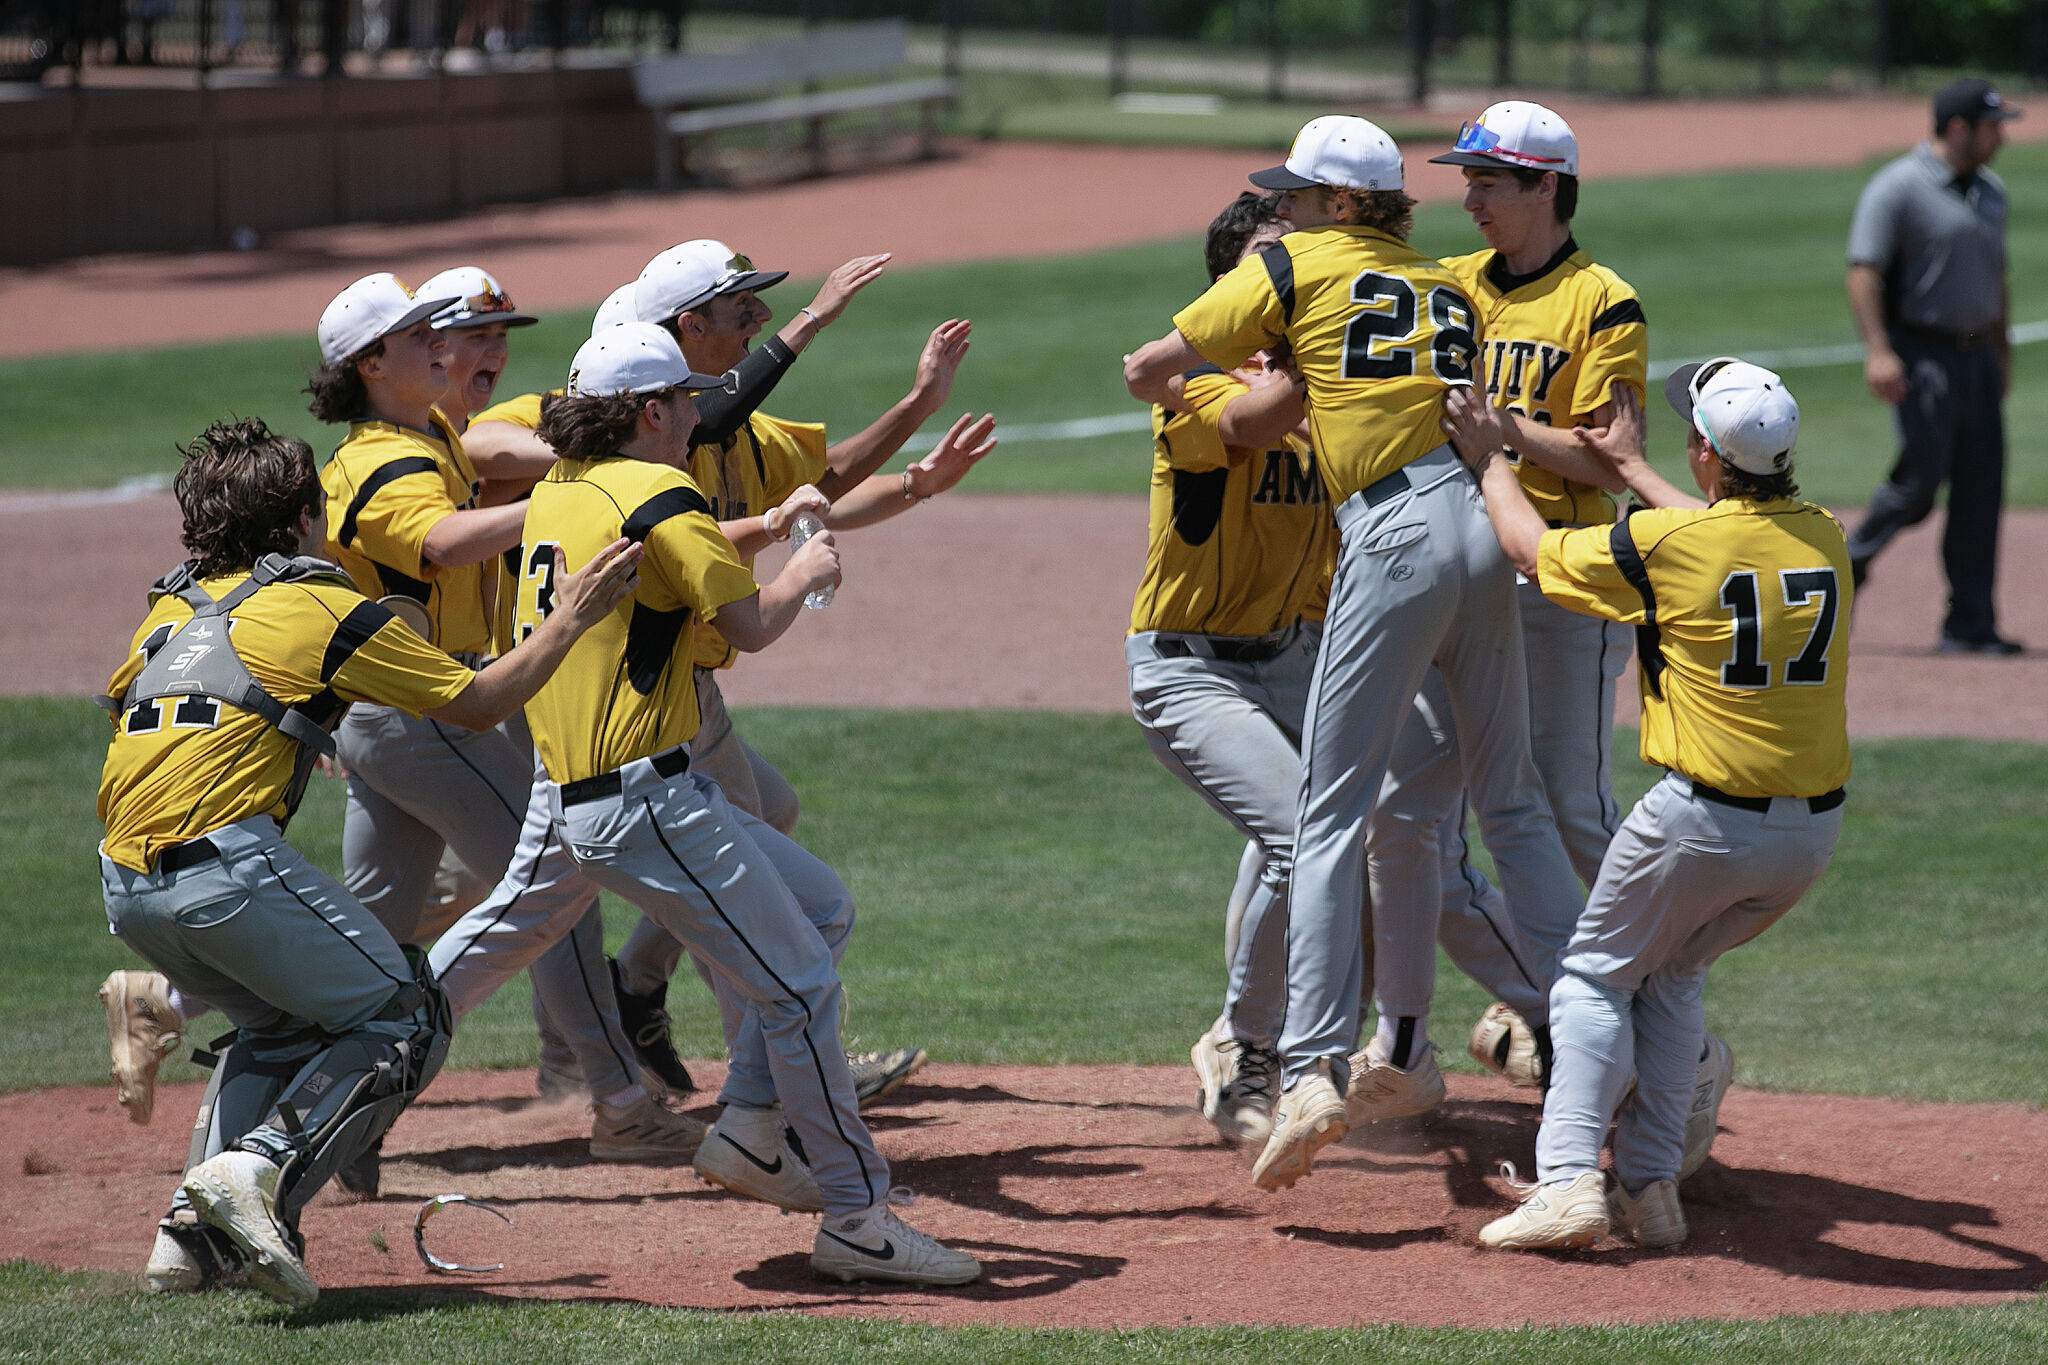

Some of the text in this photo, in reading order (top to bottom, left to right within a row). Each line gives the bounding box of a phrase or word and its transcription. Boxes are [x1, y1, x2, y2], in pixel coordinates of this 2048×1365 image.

[1341, 268, 1479, 387] 28
[1482, 338, 1573, 404] ITY
[1251, 448, 1330, 507] AM
[1719, 566, 1839, 689] 17
